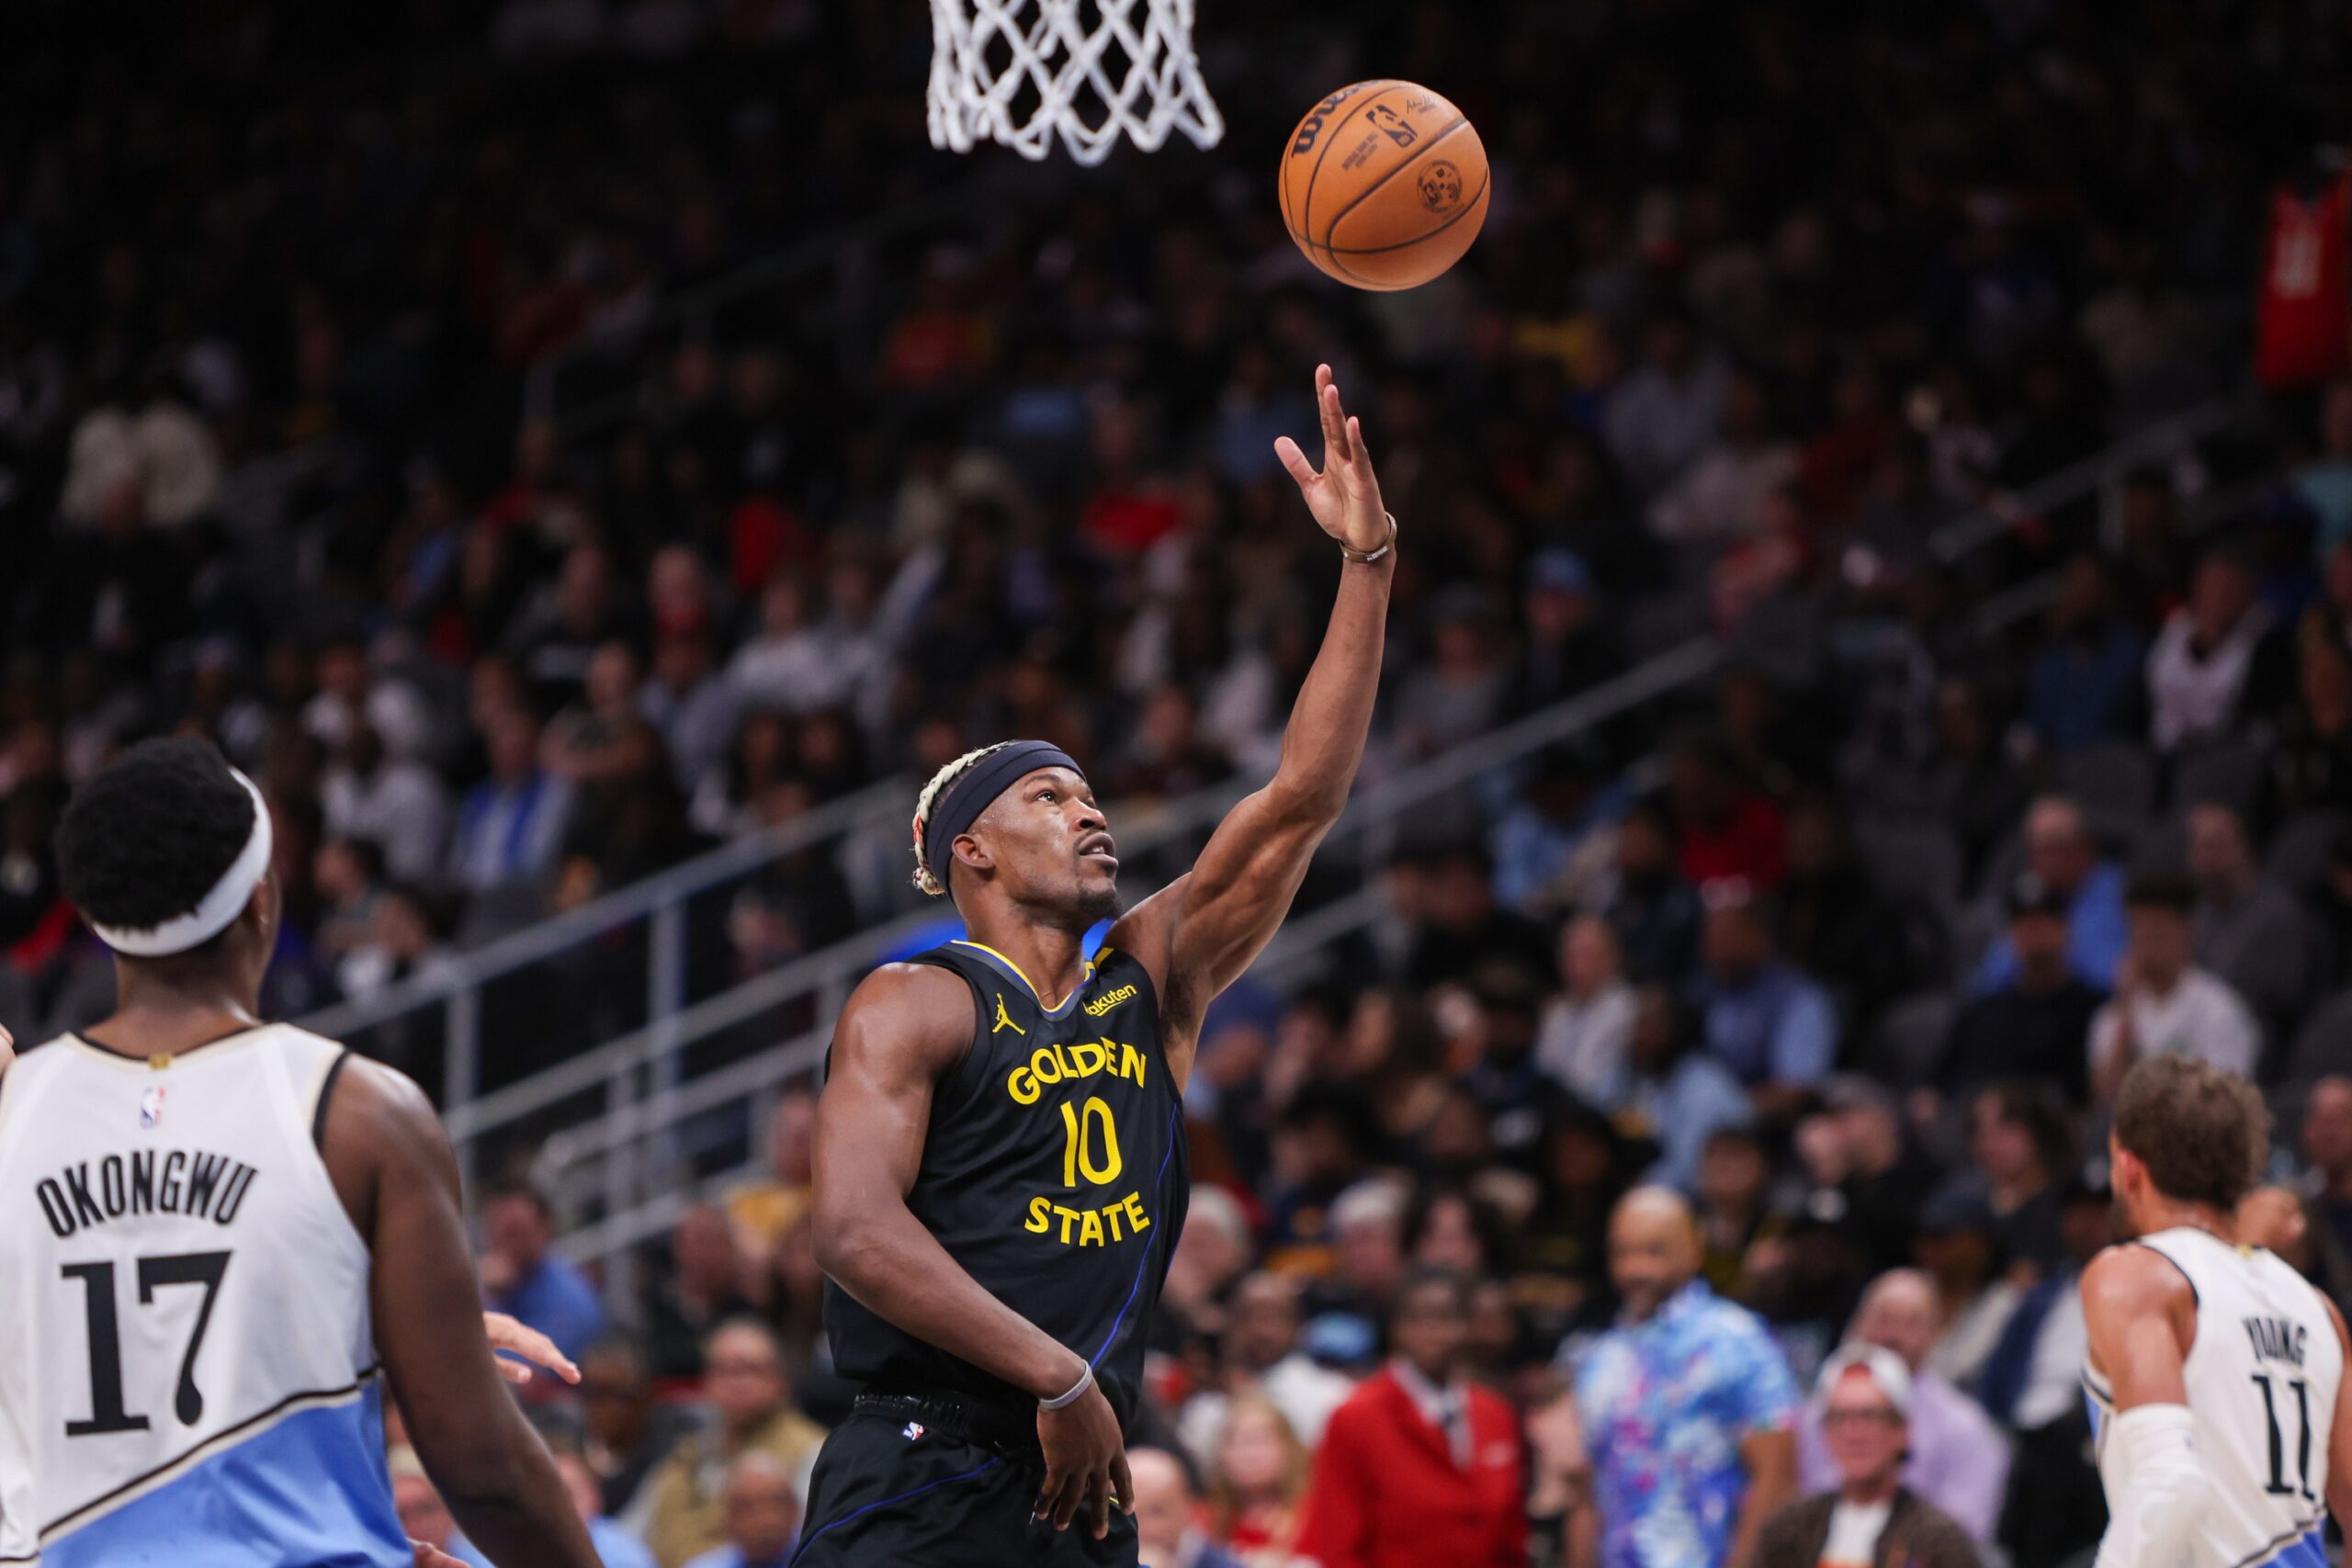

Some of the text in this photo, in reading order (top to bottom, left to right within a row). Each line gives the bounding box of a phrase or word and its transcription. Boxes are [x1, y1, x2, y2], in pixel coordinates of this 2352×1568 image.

[1082, 984, 1137, 1016] akuten
[1007, 1036, 1147, 1105] GOLDEN
[1059, 1096, 1123, 1188] 10
[35, 1149, 259, 1238] OKONGWU
[1024, 1191, 1150, 1247] STATE
[60, 1247, 235, 1437] 17
[2251, 1374, 2316, 1501] 11
